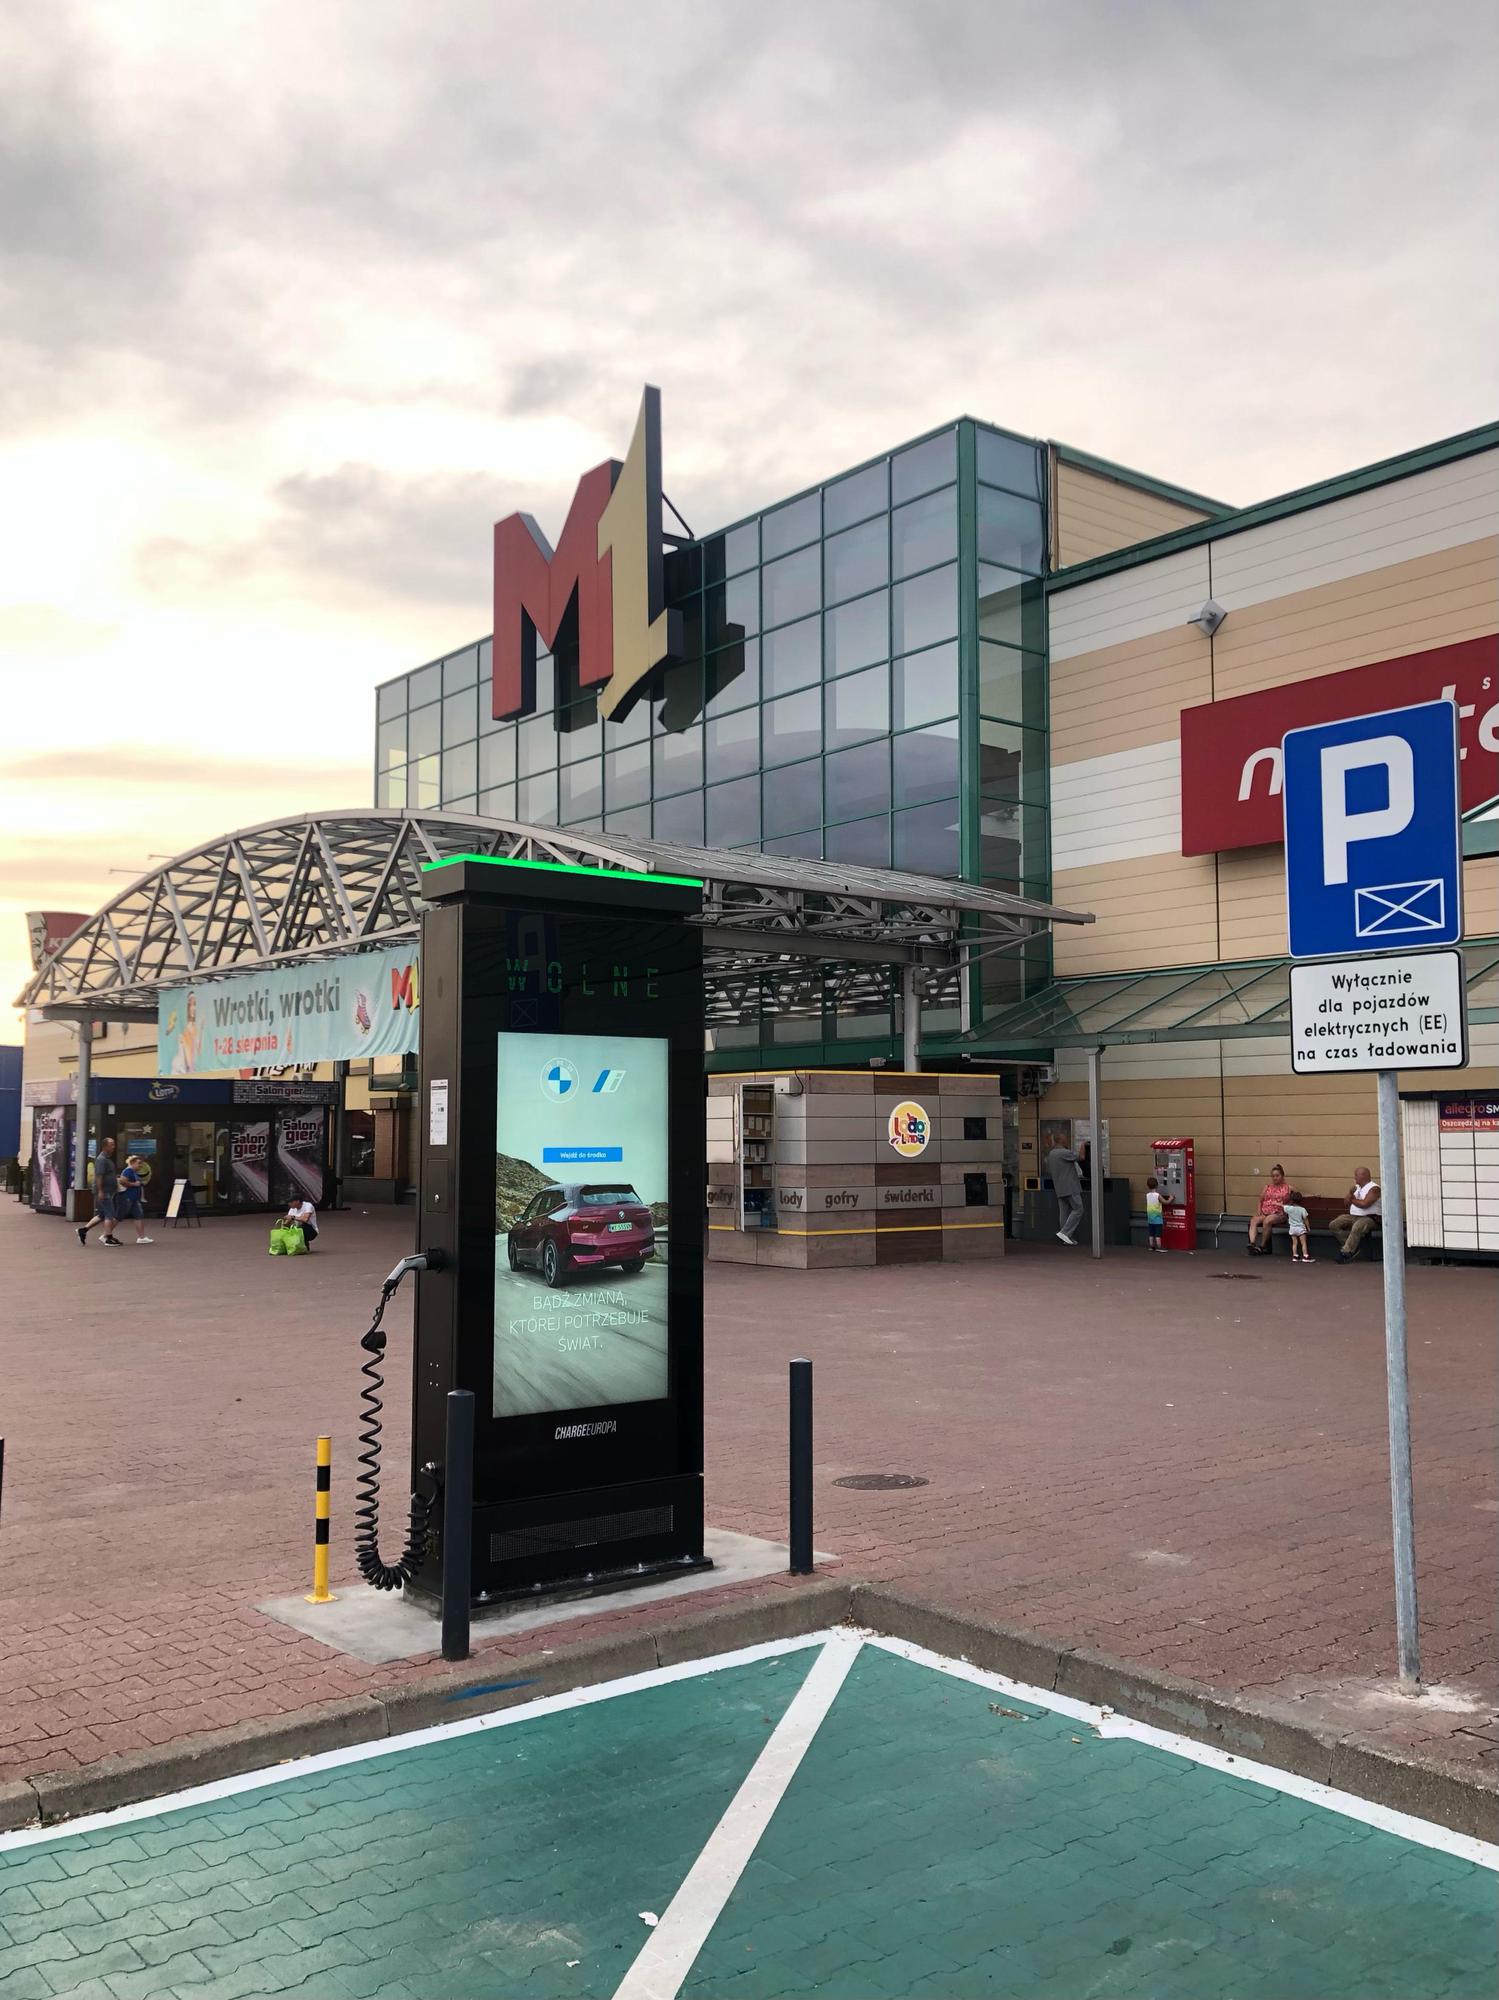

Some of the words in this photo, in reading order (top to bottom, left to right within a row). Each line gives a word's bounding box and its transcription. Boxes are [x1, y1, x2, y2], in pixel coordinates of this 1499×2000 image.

[492, 382, 684, 723] M1
[1320, 735, 1415, 886] P
[504, 958, 660, 999] WOLNE
[1331, 970, 1413, 993] Wyłącznie
[213, 988, 275, 1027] Wrotki,
[279, 977, 340, 1019] wrotki
[1318, 999, 1343, 1013] dla
[1353, 992, 1430, 1015] pojazdów
[1304, 1017, 1409, 1039] elektrycznych
[1419, 1013, 1448, 1034] (EE)
[213, 1037, 234, 1056] 1-28
[236, 1032, 278, 1055] sierpnia
[1297, 1049, 1316, 1061] na
[1325, 1046, 1358, 1059] czas
[1368, 1038, 1457, 1058] ładowania
[256, 1085, 283, 1095] Salon
[284, 1087, 304, 1097] gier
[282, 1119, 317, 1131] Salon
[232, 1133, 266, 1144] Salon
[285, 1130, 315, 1144] gier
[233, 1144, 265, 1158] gier
[707, 1188, 734, 1206] gofry
[779, 1188, 803, 1209] lody
[824, 1189, 859, 1209] gofry
[884, 1188, 934, 1204] świderki
[533, 1292, 571, 1312] BĄDŹ
[564, 1309, 649, 1329] POTRZEBUJE
[558, 1335, 604, 1352] ŚWIAT.
[554, 1420, 617, 1440] CHARGEEUROPA
